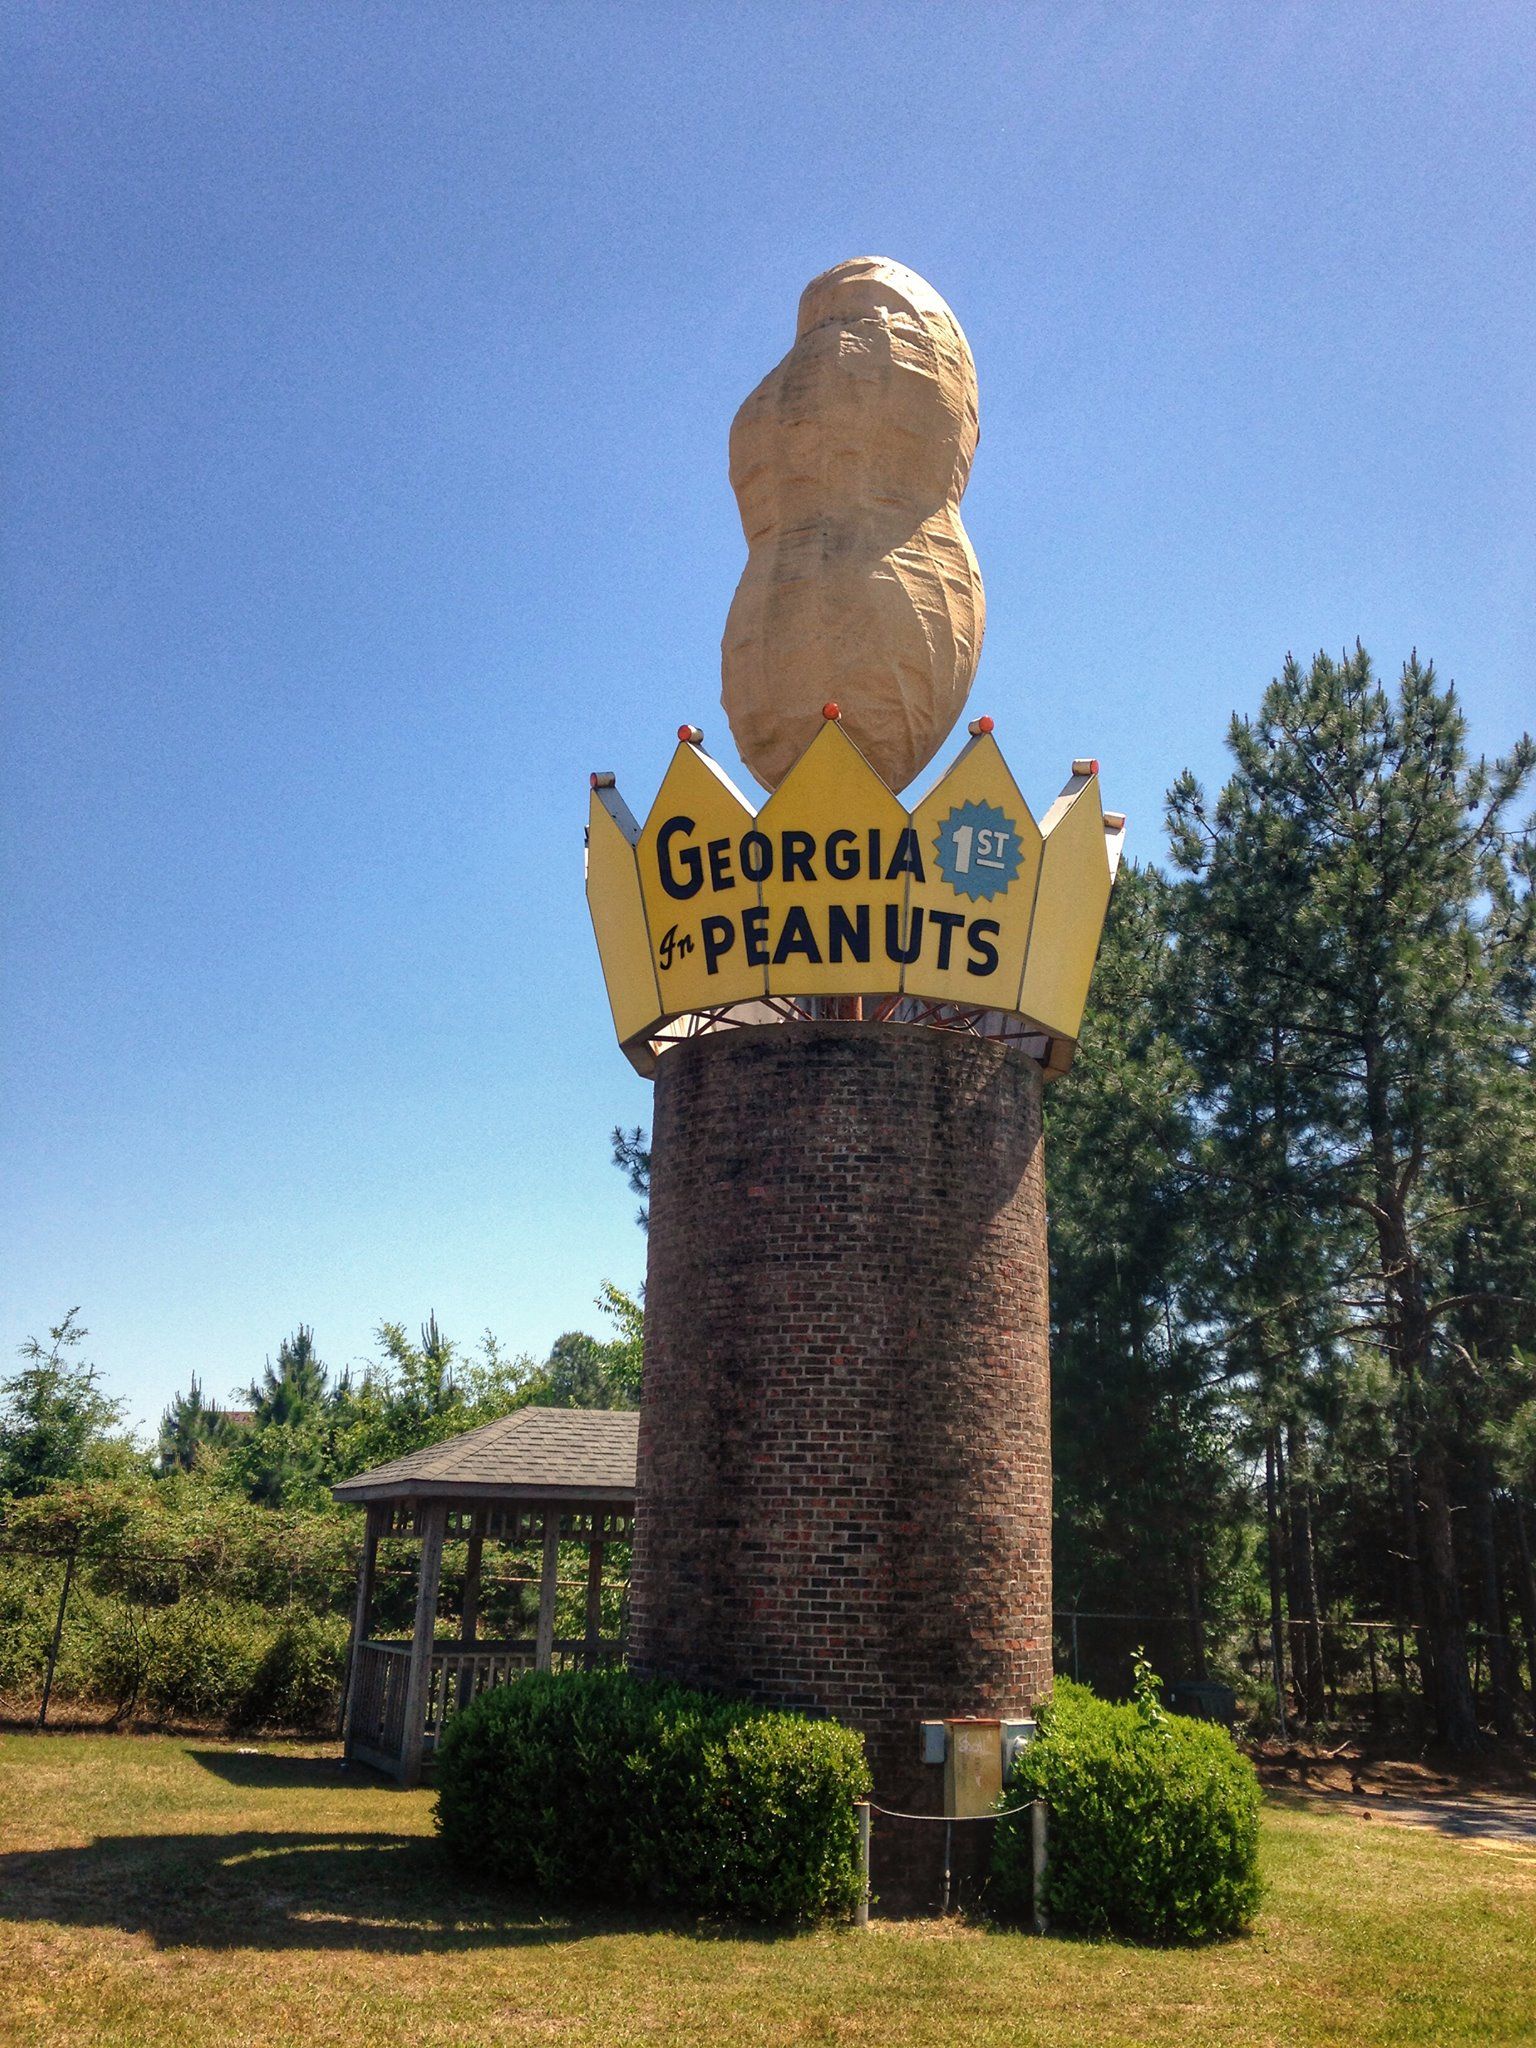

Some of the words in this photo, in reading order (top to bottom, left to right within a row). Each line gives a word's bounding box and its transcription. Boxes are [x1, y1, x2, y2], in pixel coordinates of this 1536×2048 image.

[656, 815, 926, 900] GEORGIA
[951, 824, 1010, 874] 1ST
[659, 924, 695, 971] In
[700, 904, 1001, 976] PEANUTS
